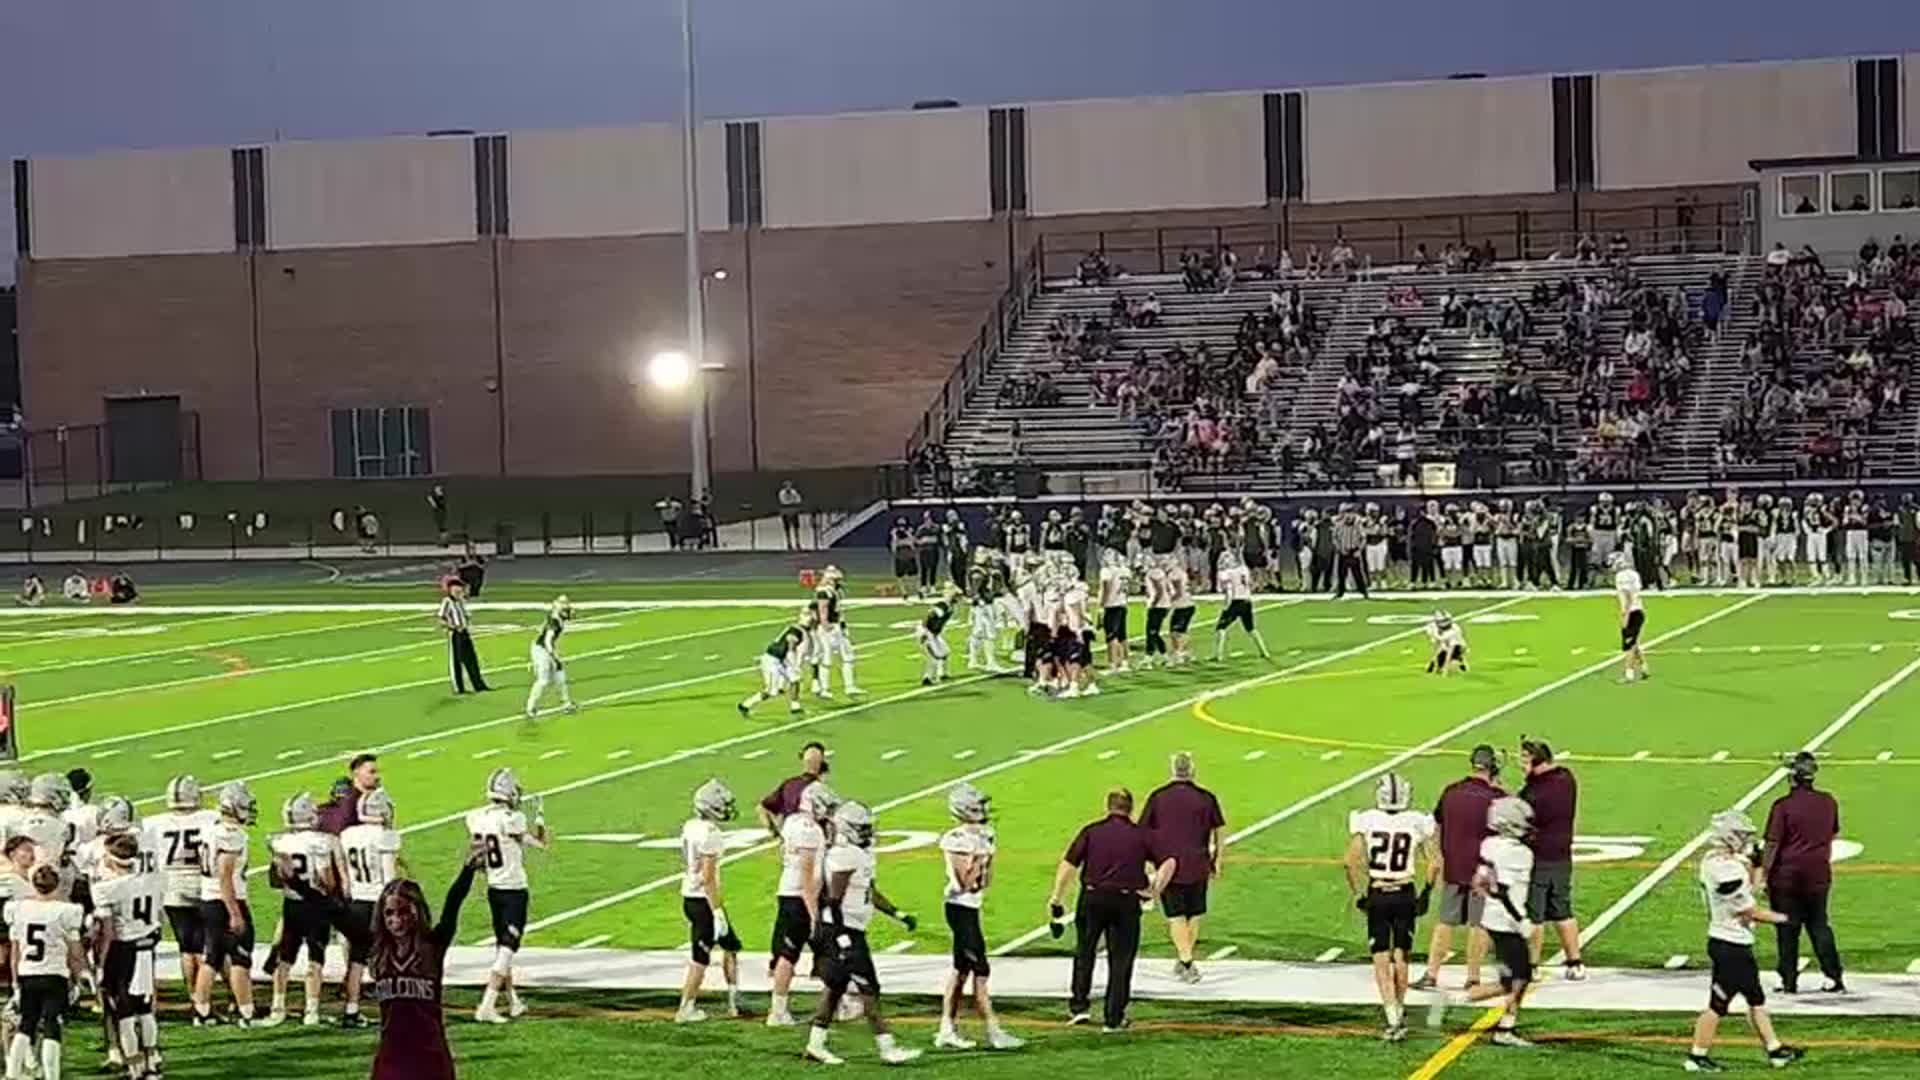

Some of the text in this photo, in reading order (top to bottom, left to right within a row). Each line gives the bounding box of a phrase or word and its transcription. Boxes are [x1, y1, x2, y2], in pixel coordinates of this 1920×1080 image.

[163, 828, 202, 866] 75
[348, 847, 371, 883] 91
[1369, 831, 1412, 872] 28
[133, 895, 153, 926] 4
[26, 922, 46, 962] 5
